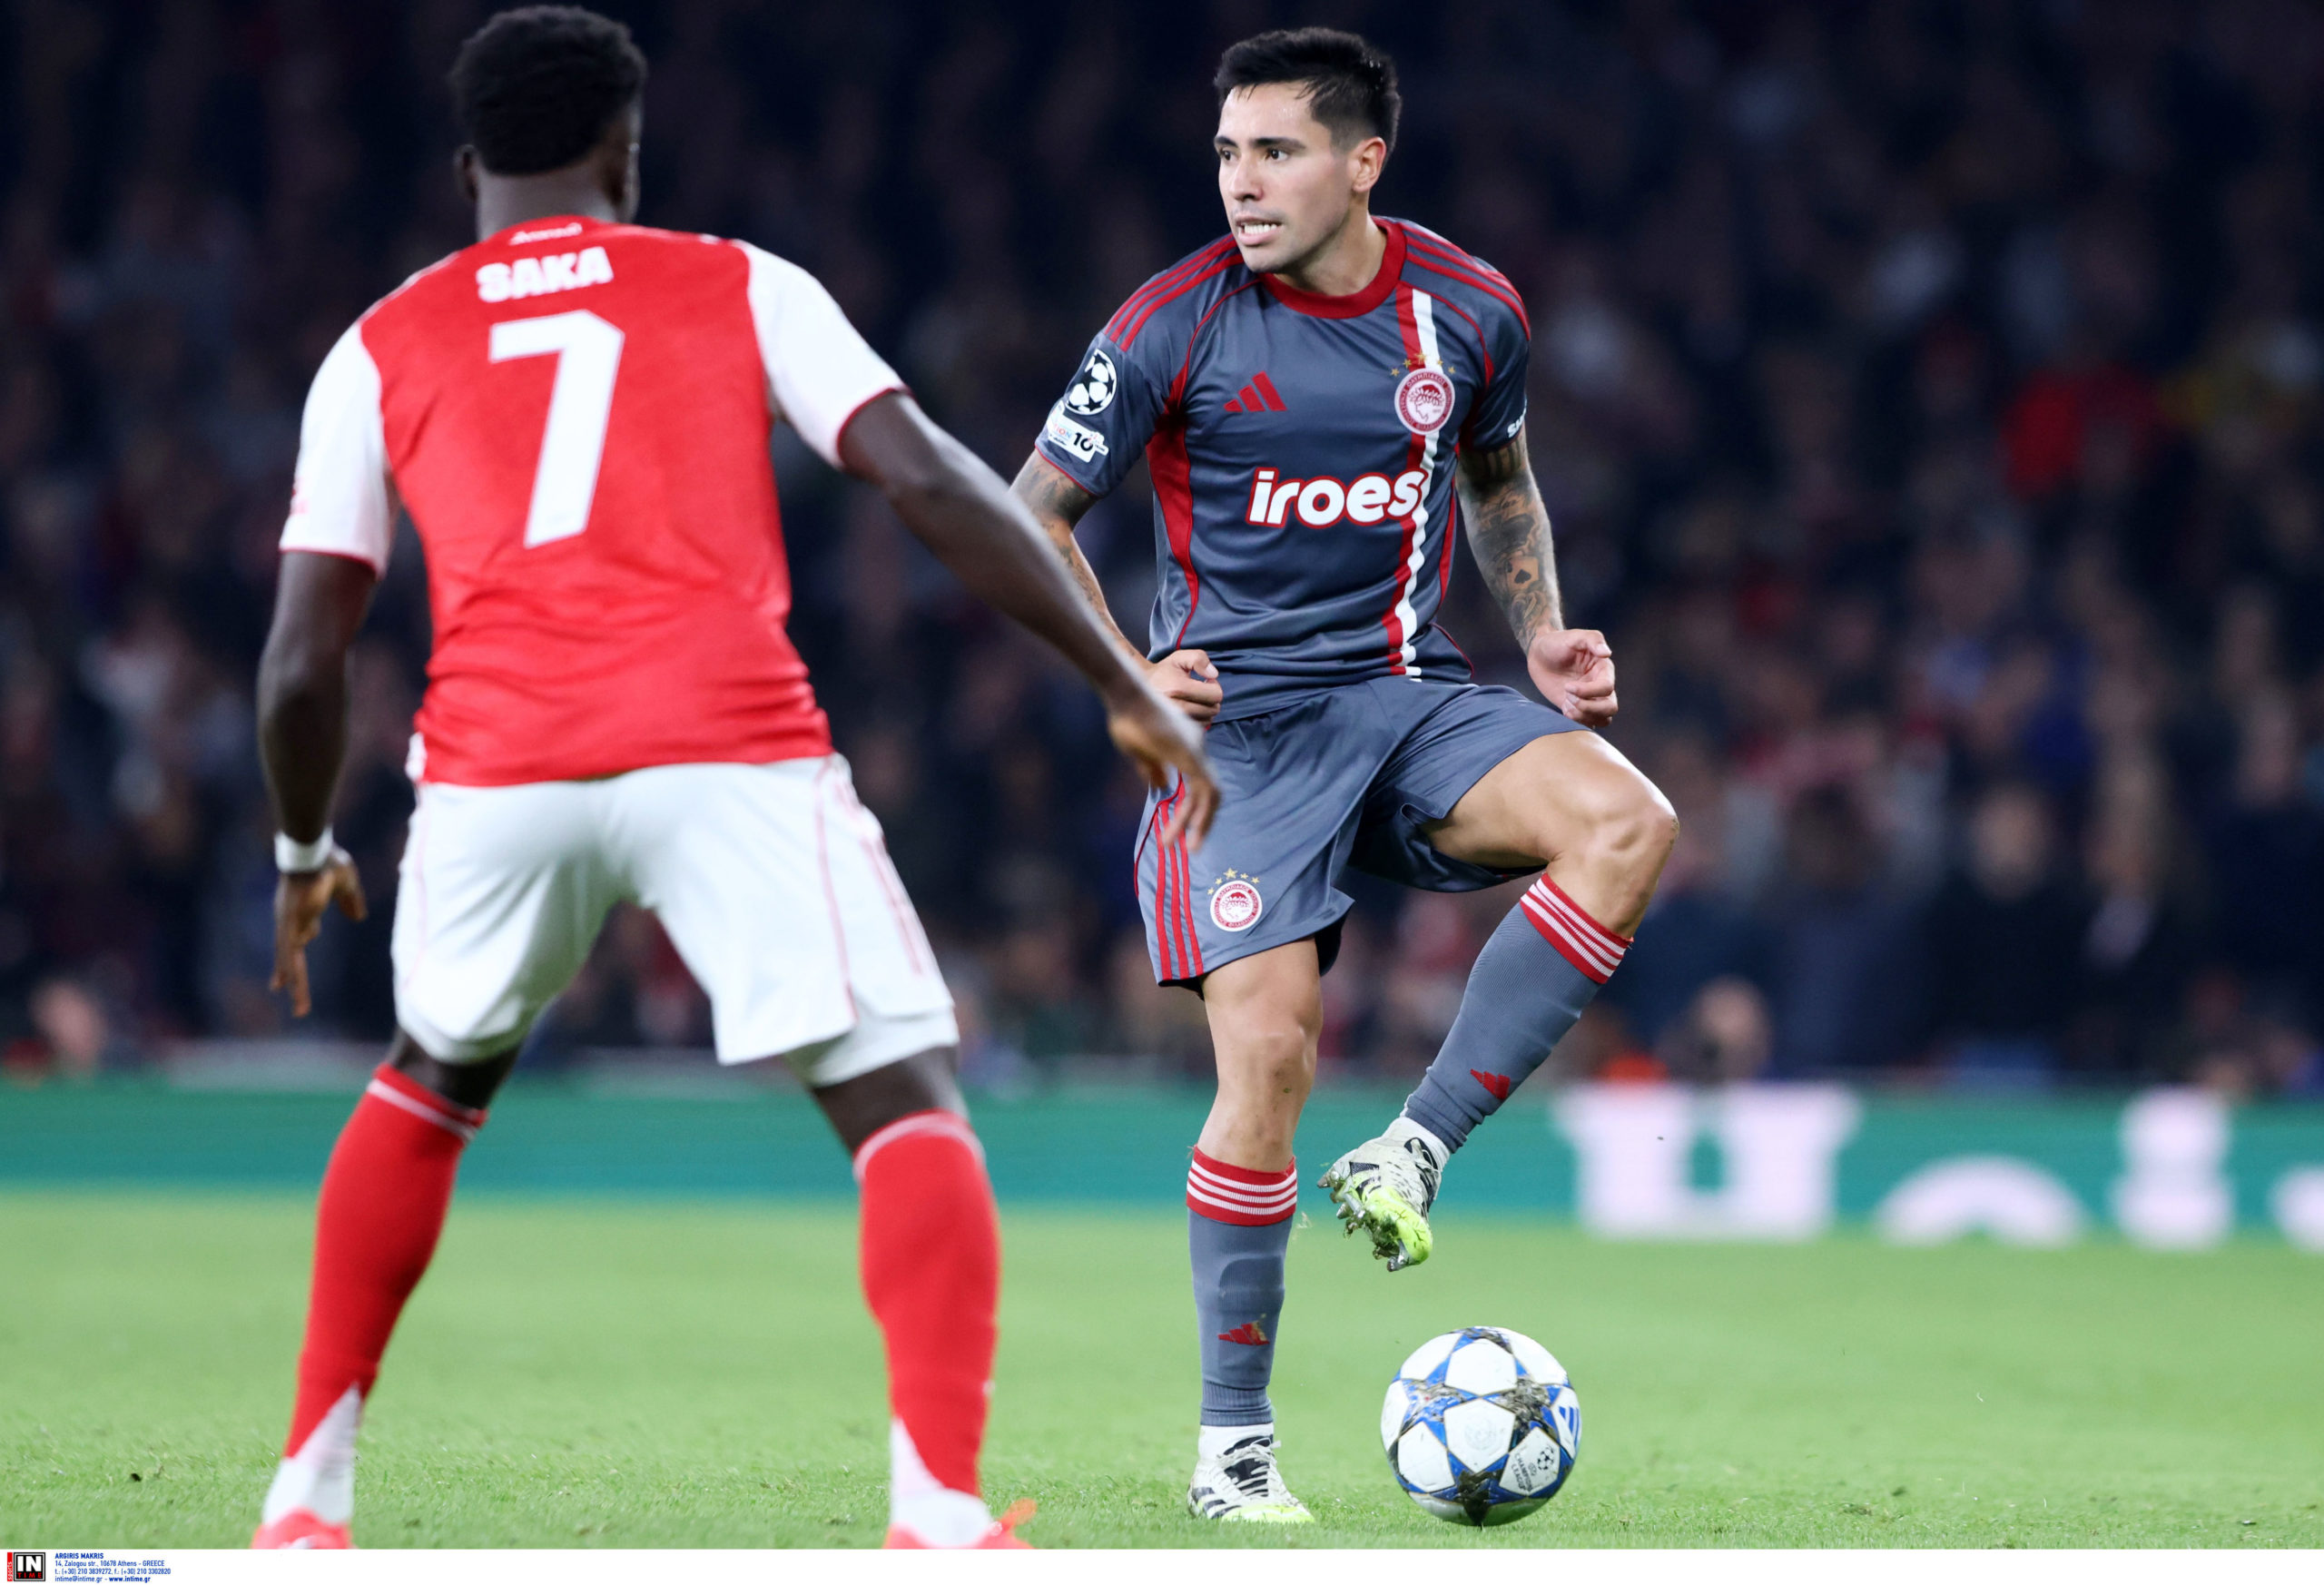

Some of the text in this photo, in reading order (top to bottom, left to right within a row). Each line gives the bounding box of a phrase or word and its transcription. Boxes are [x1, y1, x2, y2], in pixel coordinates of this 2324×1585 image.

[476, 246, 614, 303] SAKA
[488, 309, 625, 549] 7
[1245, 466, 1428, 530] iroes
